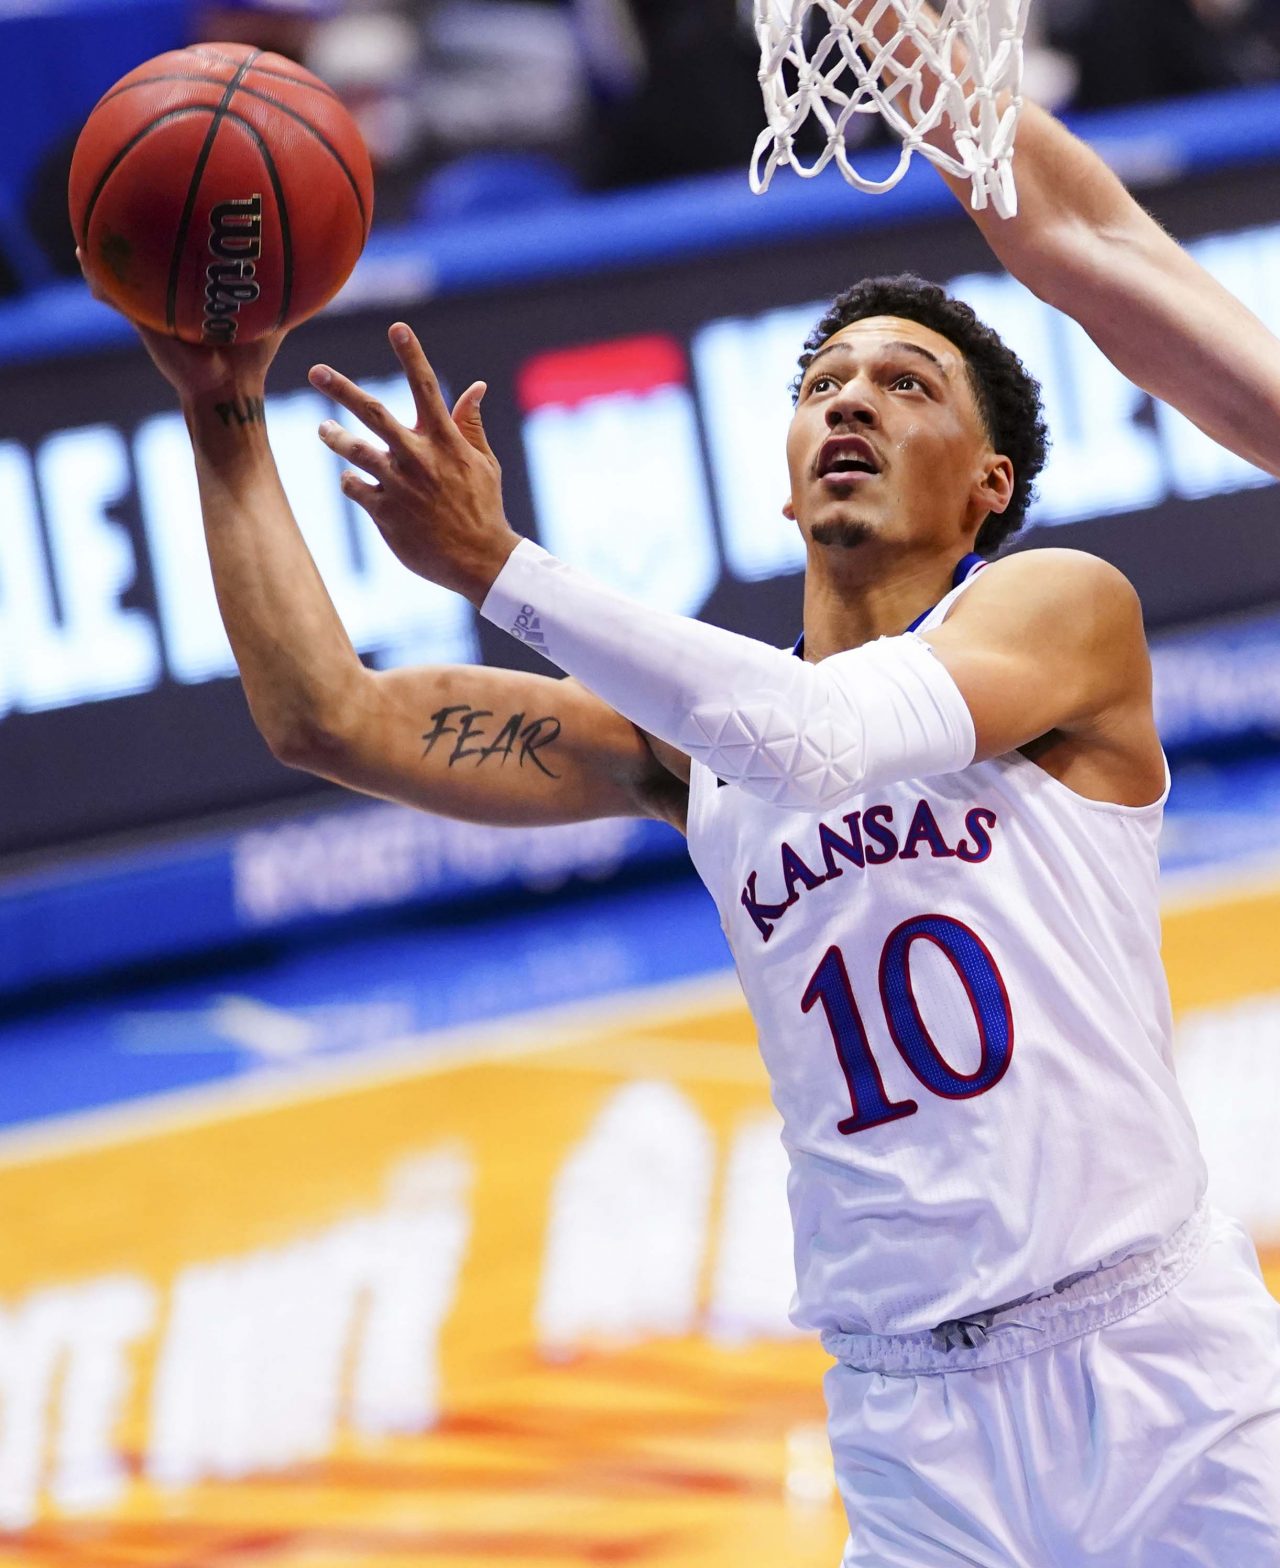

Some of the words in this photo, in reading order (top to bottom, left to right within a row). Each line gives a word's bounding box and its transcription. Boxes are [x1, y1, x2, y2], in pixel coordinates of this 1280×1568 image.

[421, 704, 561, 779] FEAR
[741, 799, 997, 942] KANSAS
[801, 914, 1014, 1135] 10
